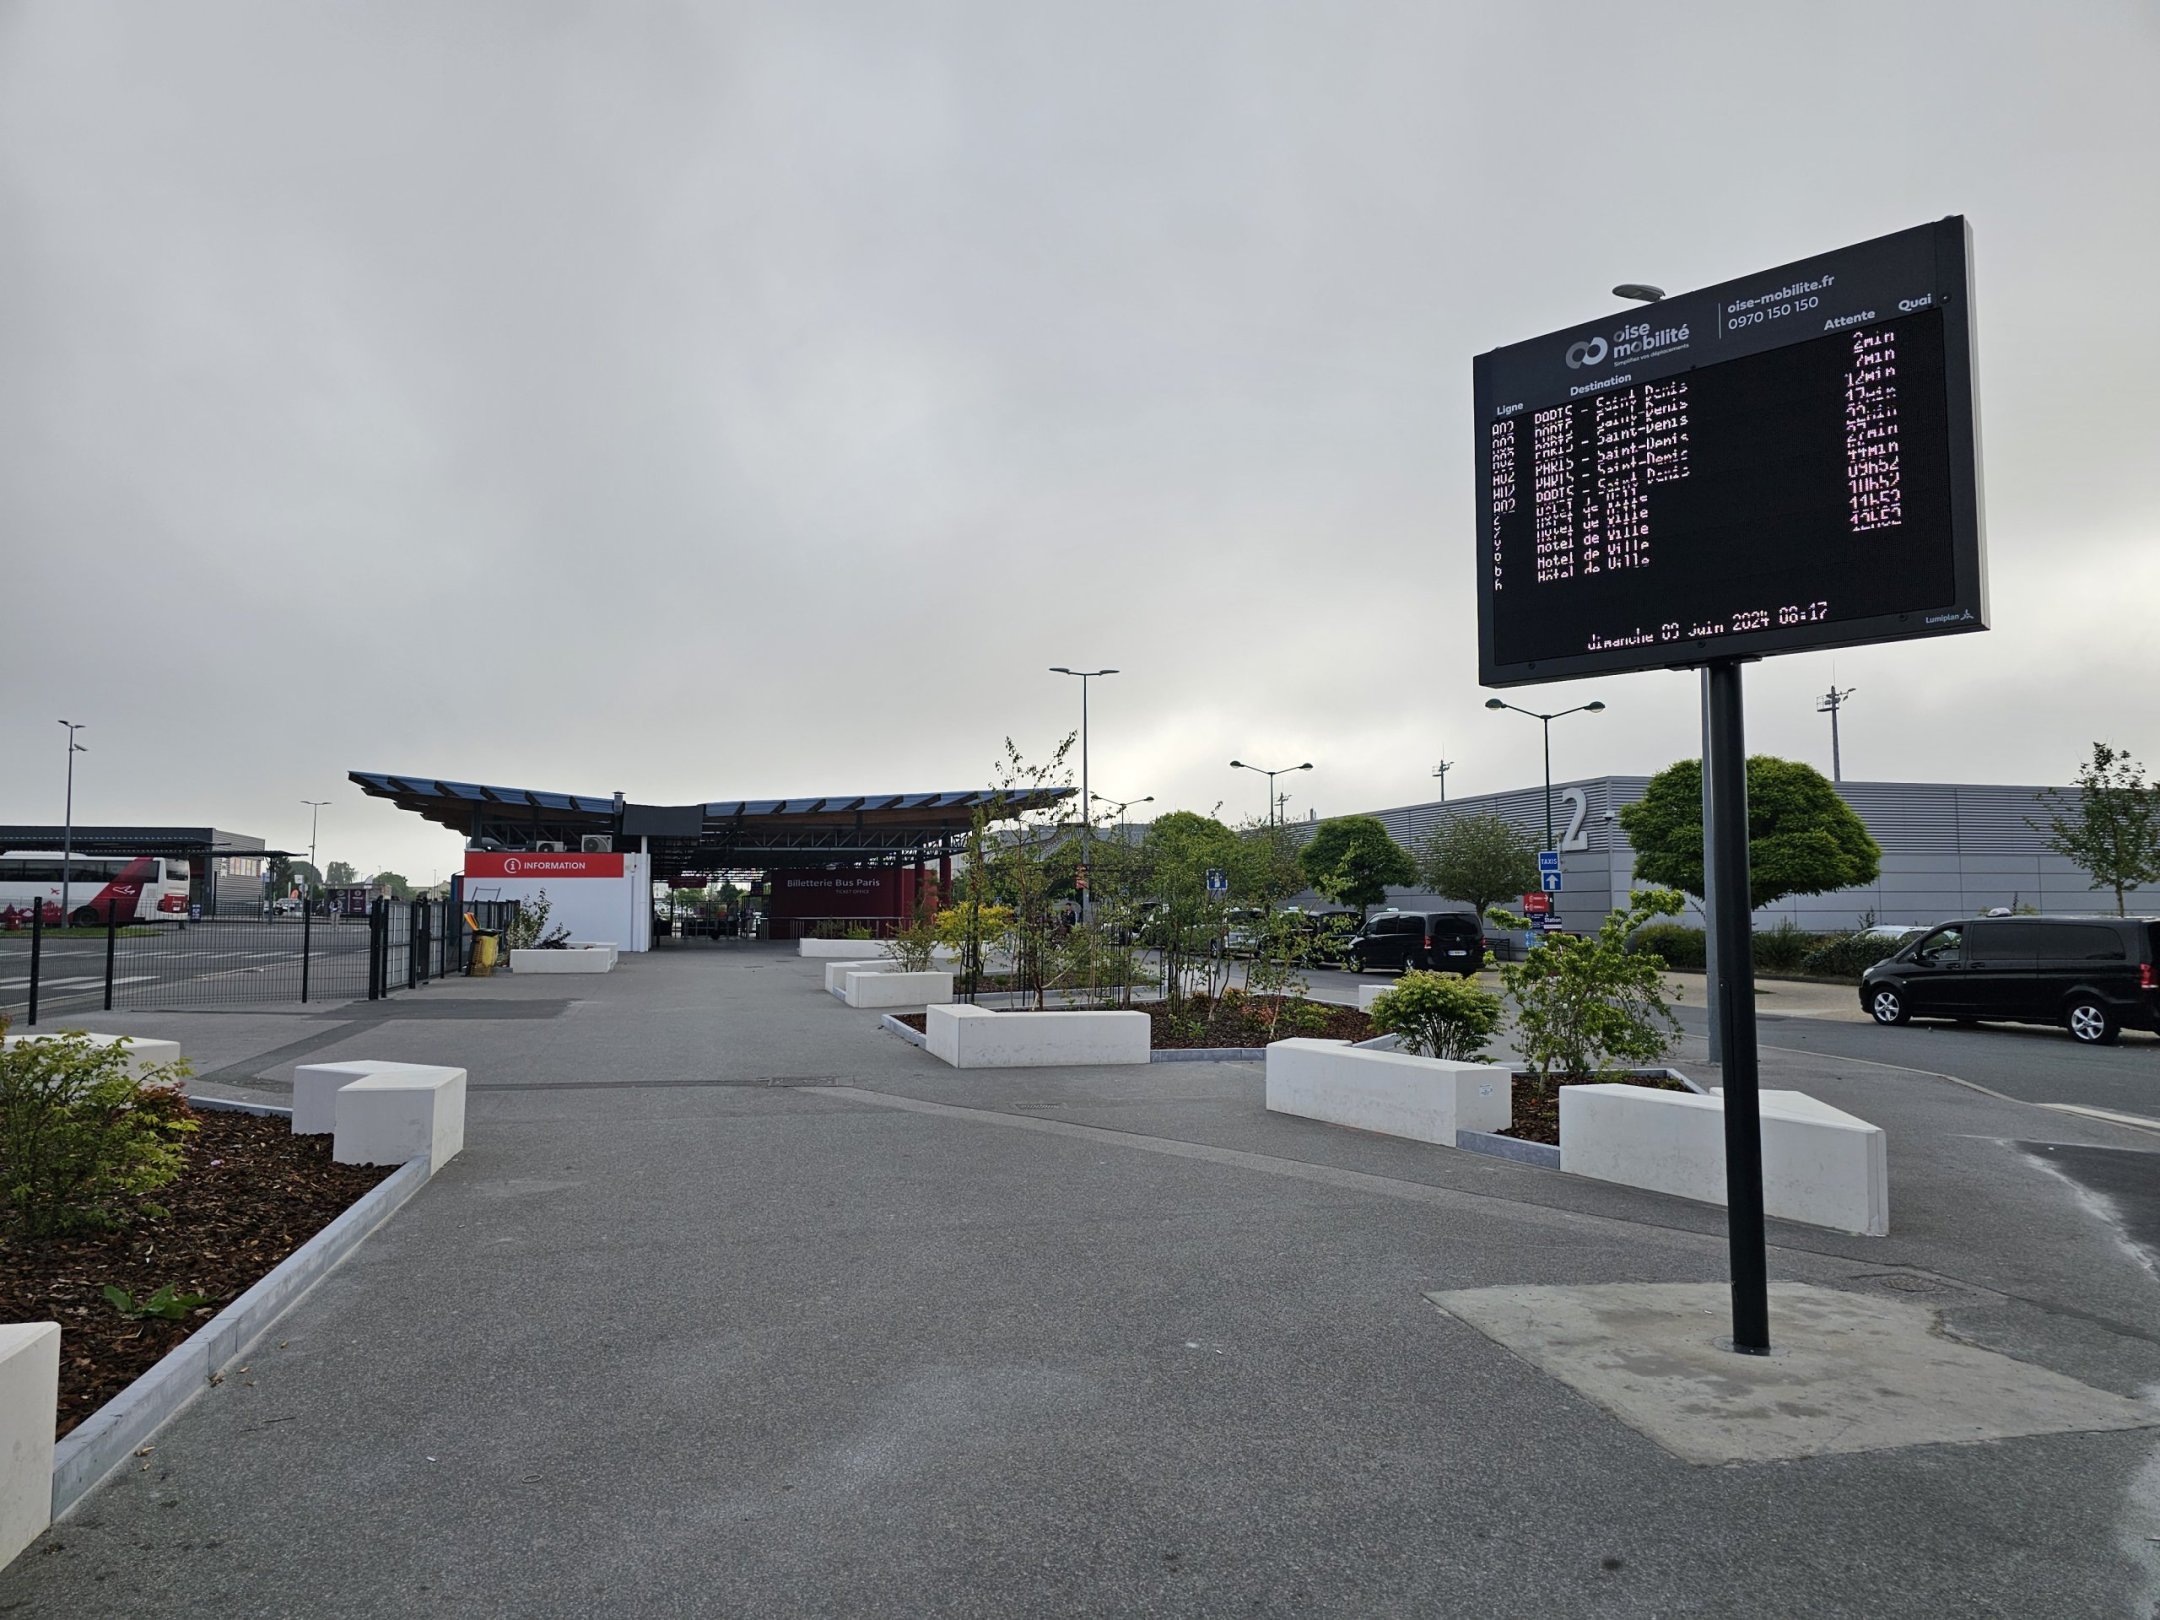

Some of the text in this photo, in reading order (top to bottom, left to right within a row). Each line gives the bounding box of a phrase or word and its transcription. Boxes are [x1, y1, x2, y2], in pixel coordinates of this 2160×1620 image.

[1727, 275, 1835, 313] oise-mobilite.fr
[1728, 296, 1819, 330] 0970 150 150
[1613, 323, 1650, 342] oise
[1613, 323, 1690, 359] mobilité
[1853, 331, 1894, 353] 2min
[1496, 293, 1932, 416] Ligne Destination Attente Quai
[1597, 415, 1688, 445] Saint-Denis
[1845, 366, 1895, 387] 12min
[1536, 456, 1574, 476] PARIS
[1598, 433, 1689, 462] Saint-Denis
[1847, 441, 1898, 459] 44min
[1536, 472, 1574, 490] PARIS
[1598, 449, 1687, 474] Saint-Denis
[1848, 456, 1899, 478] 09h52
[1608, 521, 1648, 540] Ville
[1584, 548, 1599, 560] de
[1608, 539, 1649, 555] Ville
[1585, 562, 1600, 574] de
[1608, 554, 1649, 569] Ville
[1925, 614, 1960, 624] Lumiplan
[1588, 627, 1654, 650] dimanche
[1688, 620, 1724, 637] juin
[1733, 611, 1770, 631] 2024
[1560, 787, 1588, 851] 2
[524, 862, 586, 870] INFORMATION
[787, 878, 881, 888] Billetterie Bus Paris
